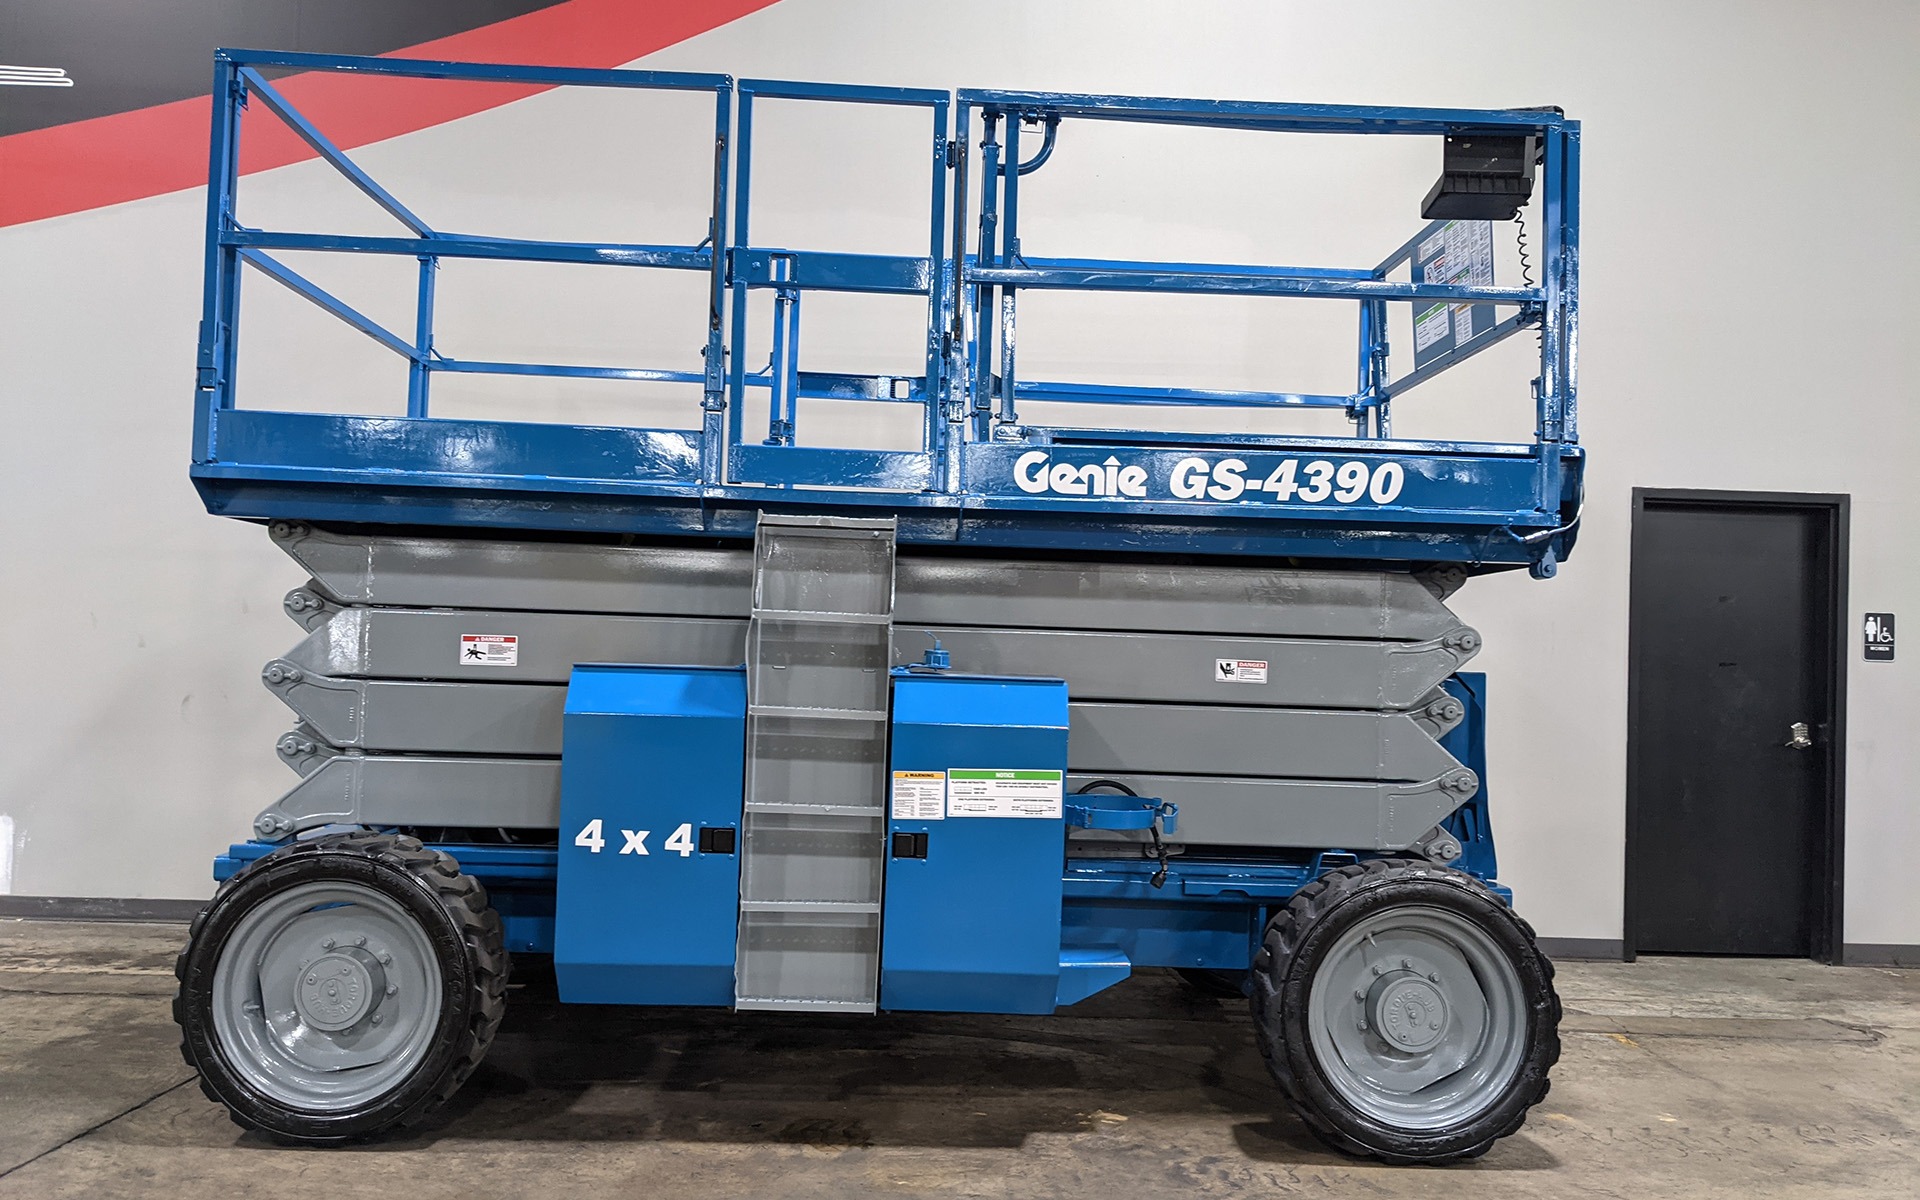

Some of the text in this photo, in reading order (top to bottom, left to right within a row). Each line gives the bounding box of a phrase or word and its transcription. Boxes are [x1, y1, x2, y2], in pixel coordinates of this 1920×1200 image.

[1013, 450, 1405, 504] Genie GS-4390
[575, 819, 695, 857] 4 x 4
